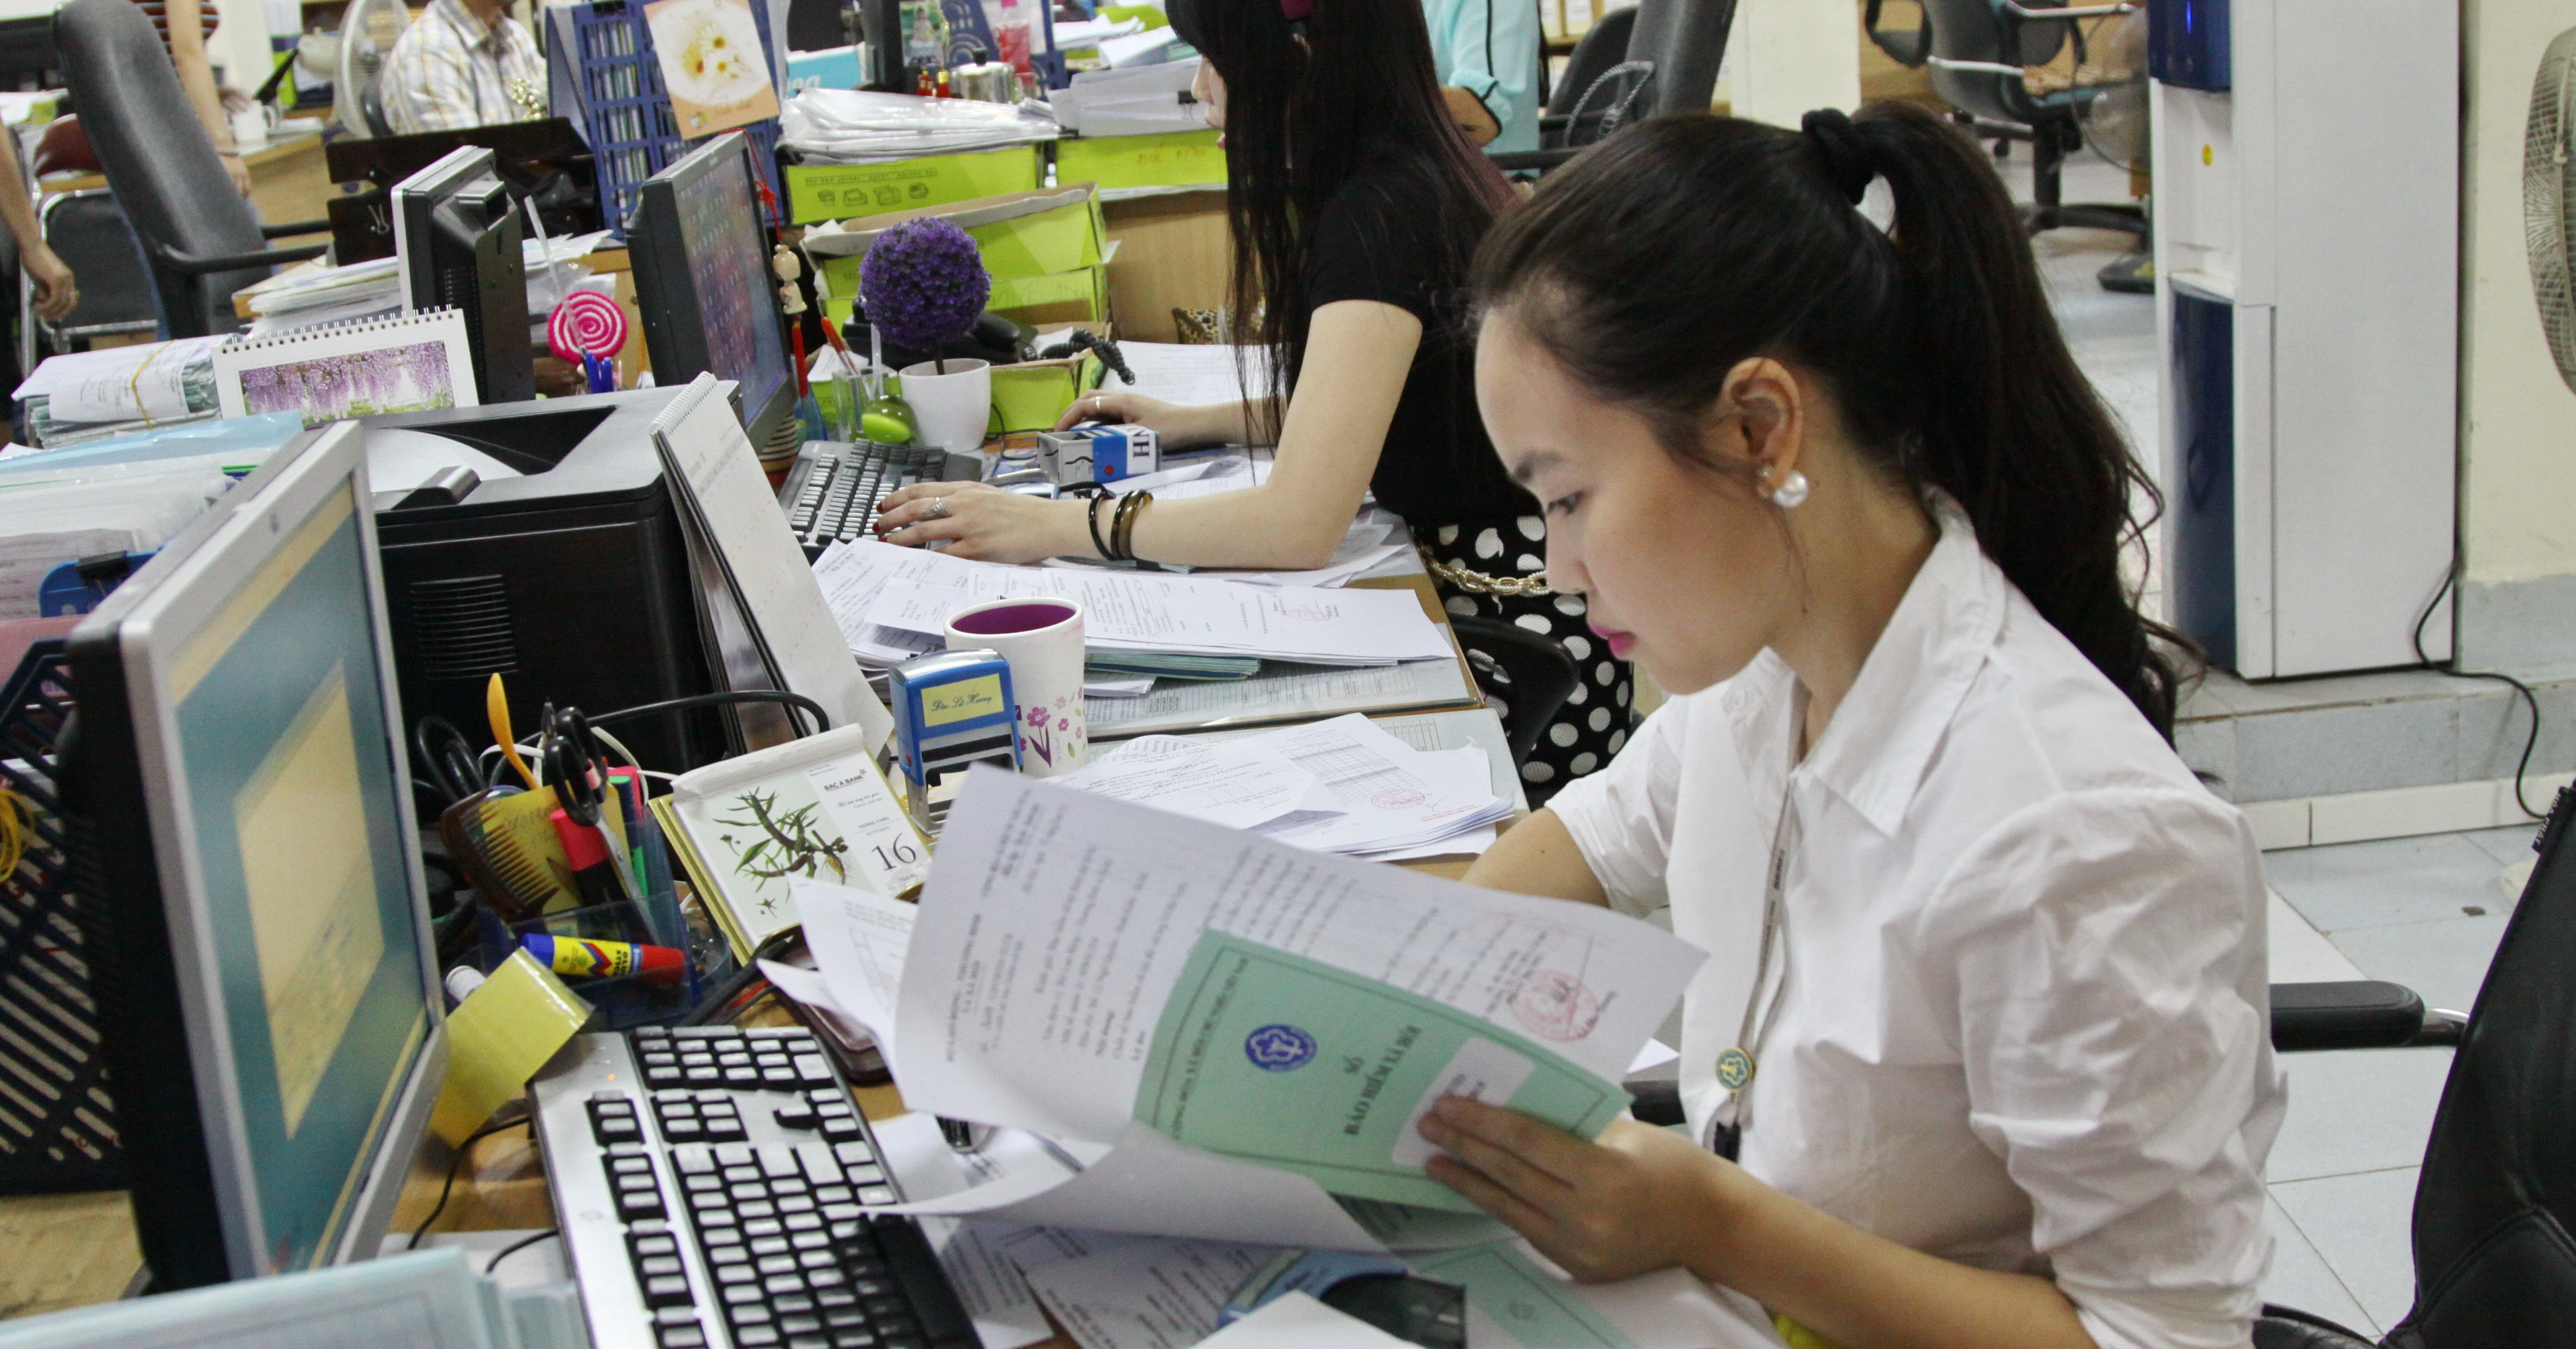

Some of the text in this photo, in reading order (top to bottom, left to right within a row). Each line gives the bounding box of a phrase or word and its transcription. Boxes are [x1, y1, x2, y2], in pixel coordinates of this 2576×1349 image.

[823, 782, 838, 791] BAC
[845, 774, 864, 784] BANK
[871, 832, 917, 871] 16
